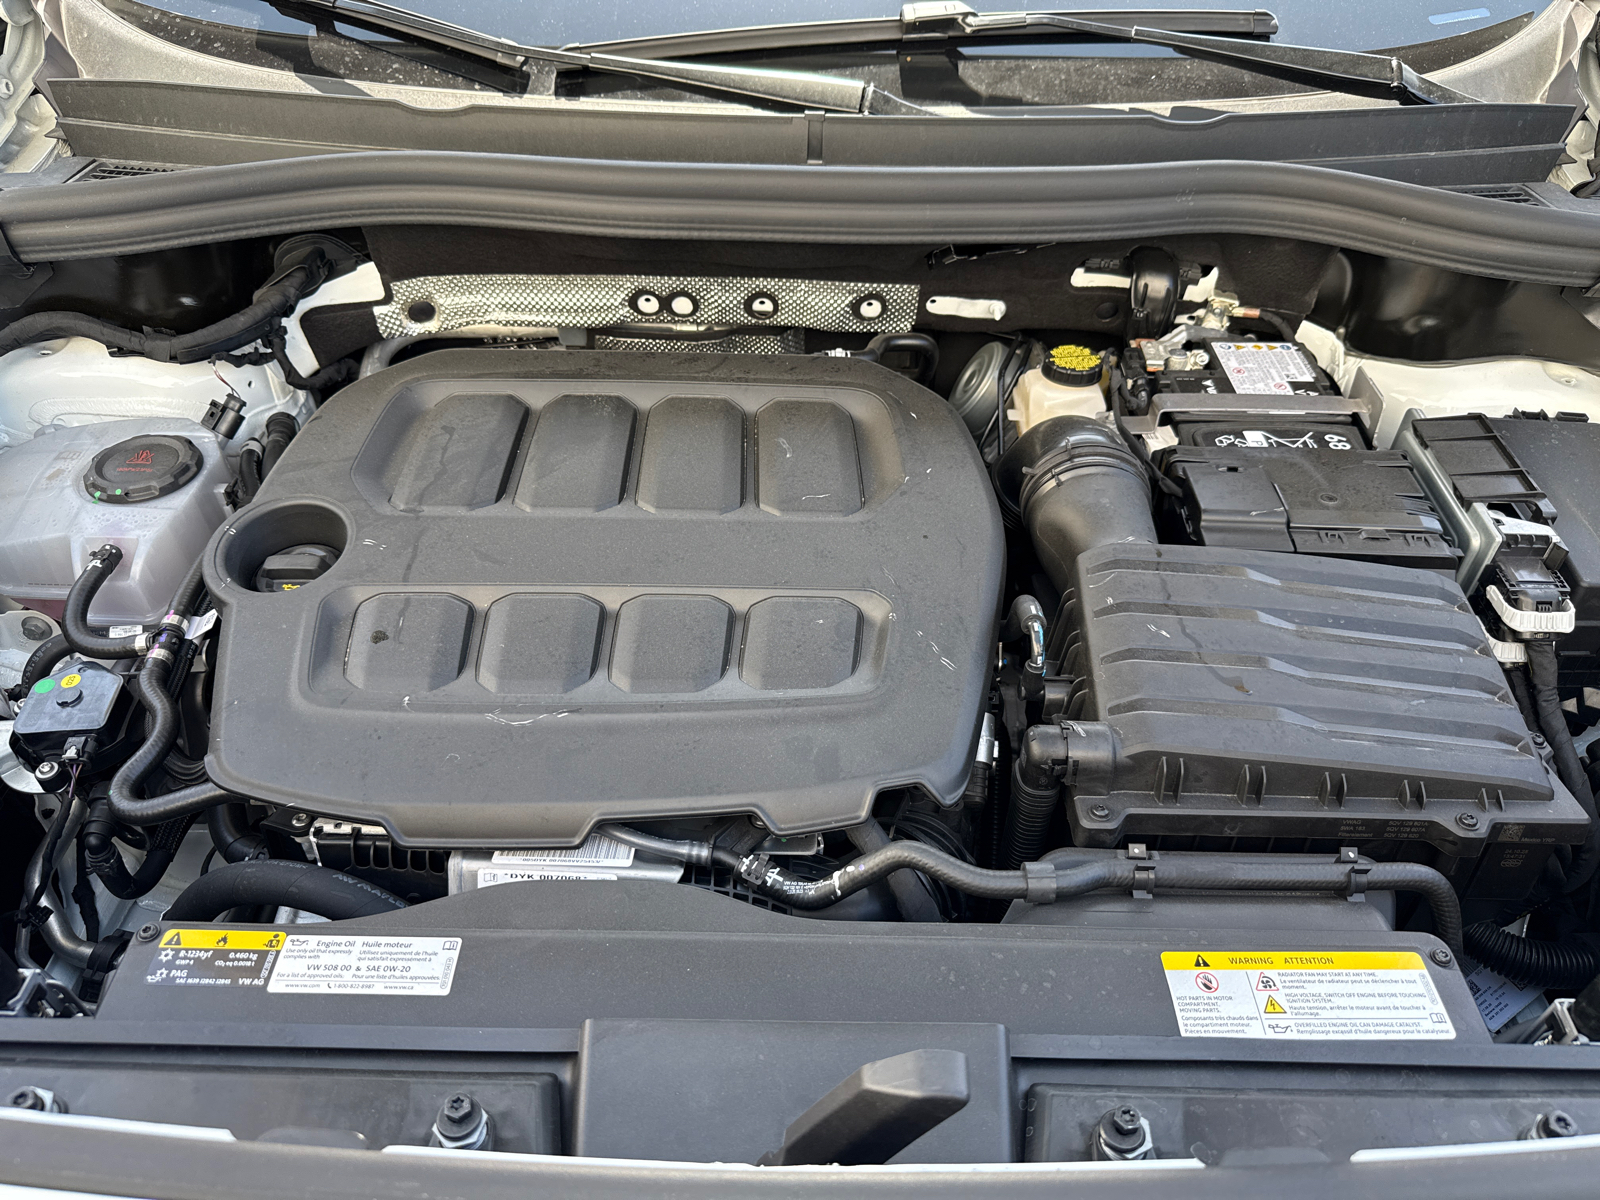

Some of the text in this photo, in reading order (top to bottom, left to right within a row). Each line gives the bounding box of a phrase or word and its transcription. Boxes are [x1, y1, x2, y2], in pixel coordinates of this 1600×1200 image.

[179, 950, 213, 960] R-1234yf
[1228, 957, 1334, 965] WARNING ATTENTION
